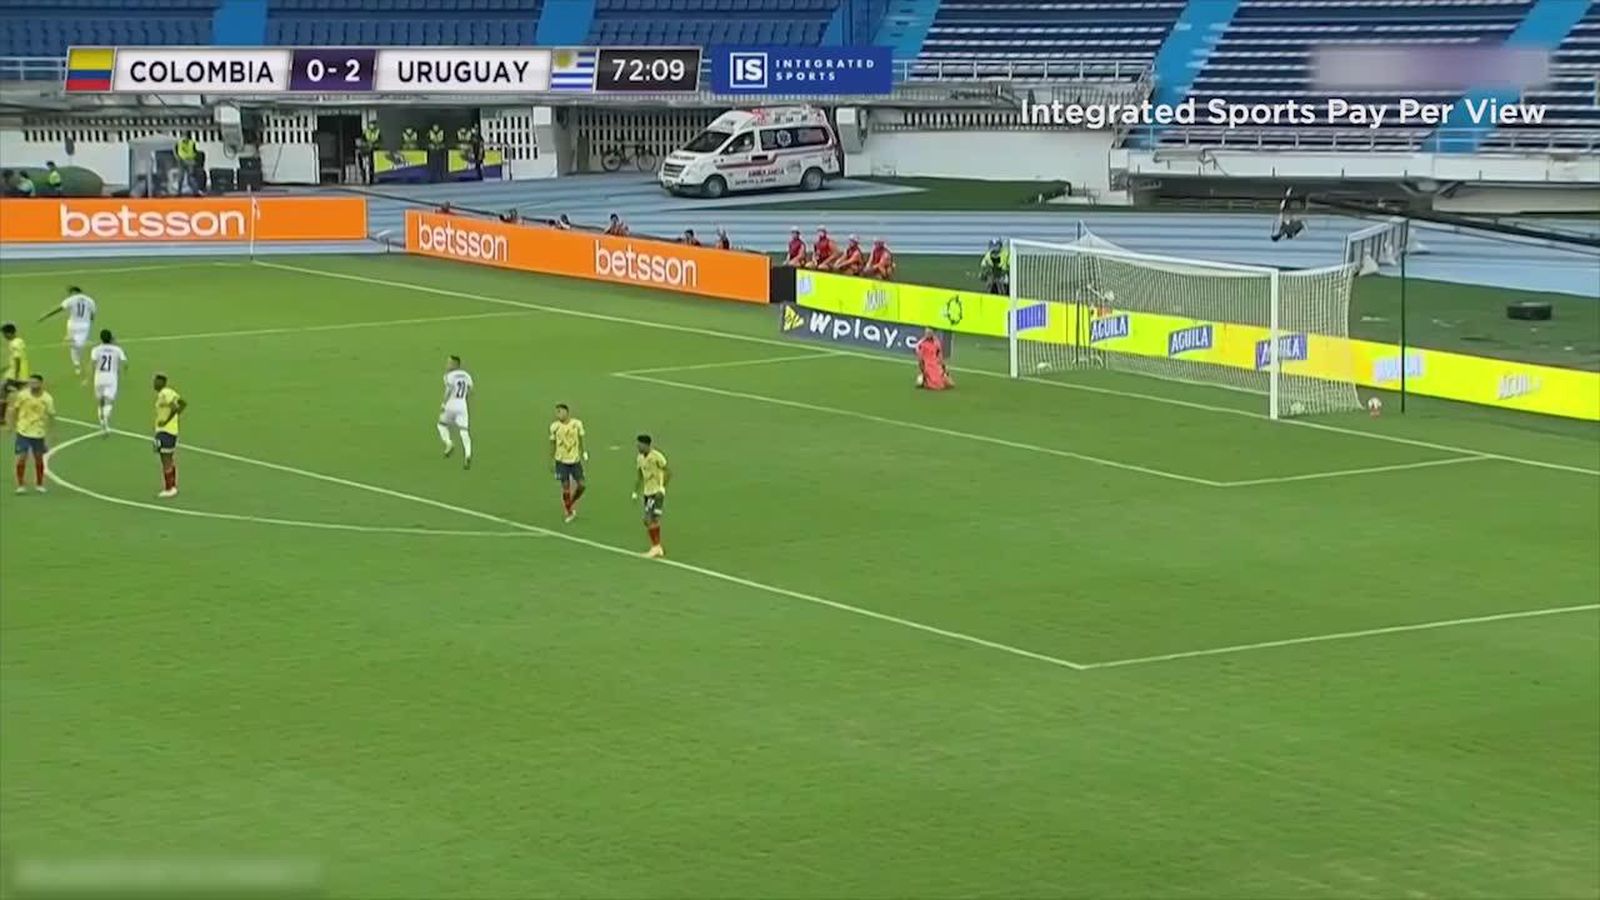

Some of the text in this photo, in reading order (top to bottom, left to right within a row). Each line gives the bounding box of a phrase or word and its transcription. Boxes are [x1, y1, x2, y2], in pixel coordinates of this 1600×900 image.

[59, 204, 245, 238] betsson
[418, 215, 508, 262] betsson
[595, 240, 698, 288] betsson
[1091, 315, 1127, 342] AGUILA
[1170, 326, 1209, 353] AGUILA
[99, 354, 112, 372] 21
